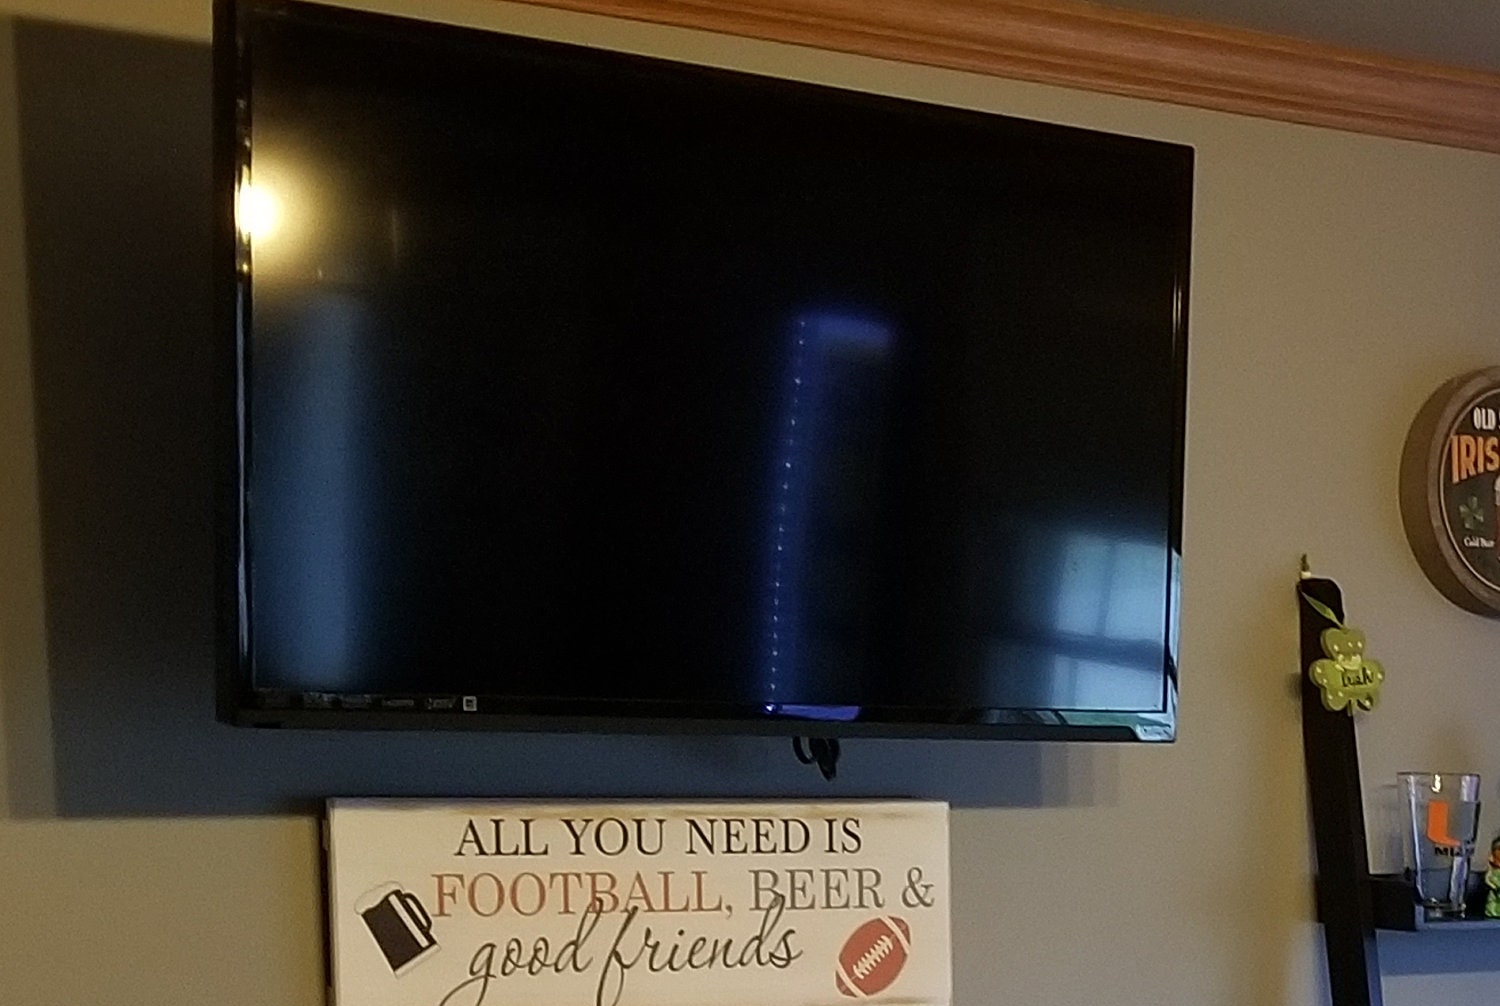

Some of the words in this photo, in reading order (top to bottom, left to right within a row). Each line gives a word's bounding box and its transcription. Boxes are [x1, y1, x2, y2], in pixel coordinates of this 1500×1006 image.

[1473, 407, 1496, 430] OLD
[455, 819, 548, 857] ALL
[561, 818, 665, 856] YOU
[684, 818, 811, 855] NEED
[825, 818, 862, 853] IS
[431, 869, 734, 919] FOOTBALL,
[749, 867, 886, 911] BEER
[901, 866, 936, 908] &
